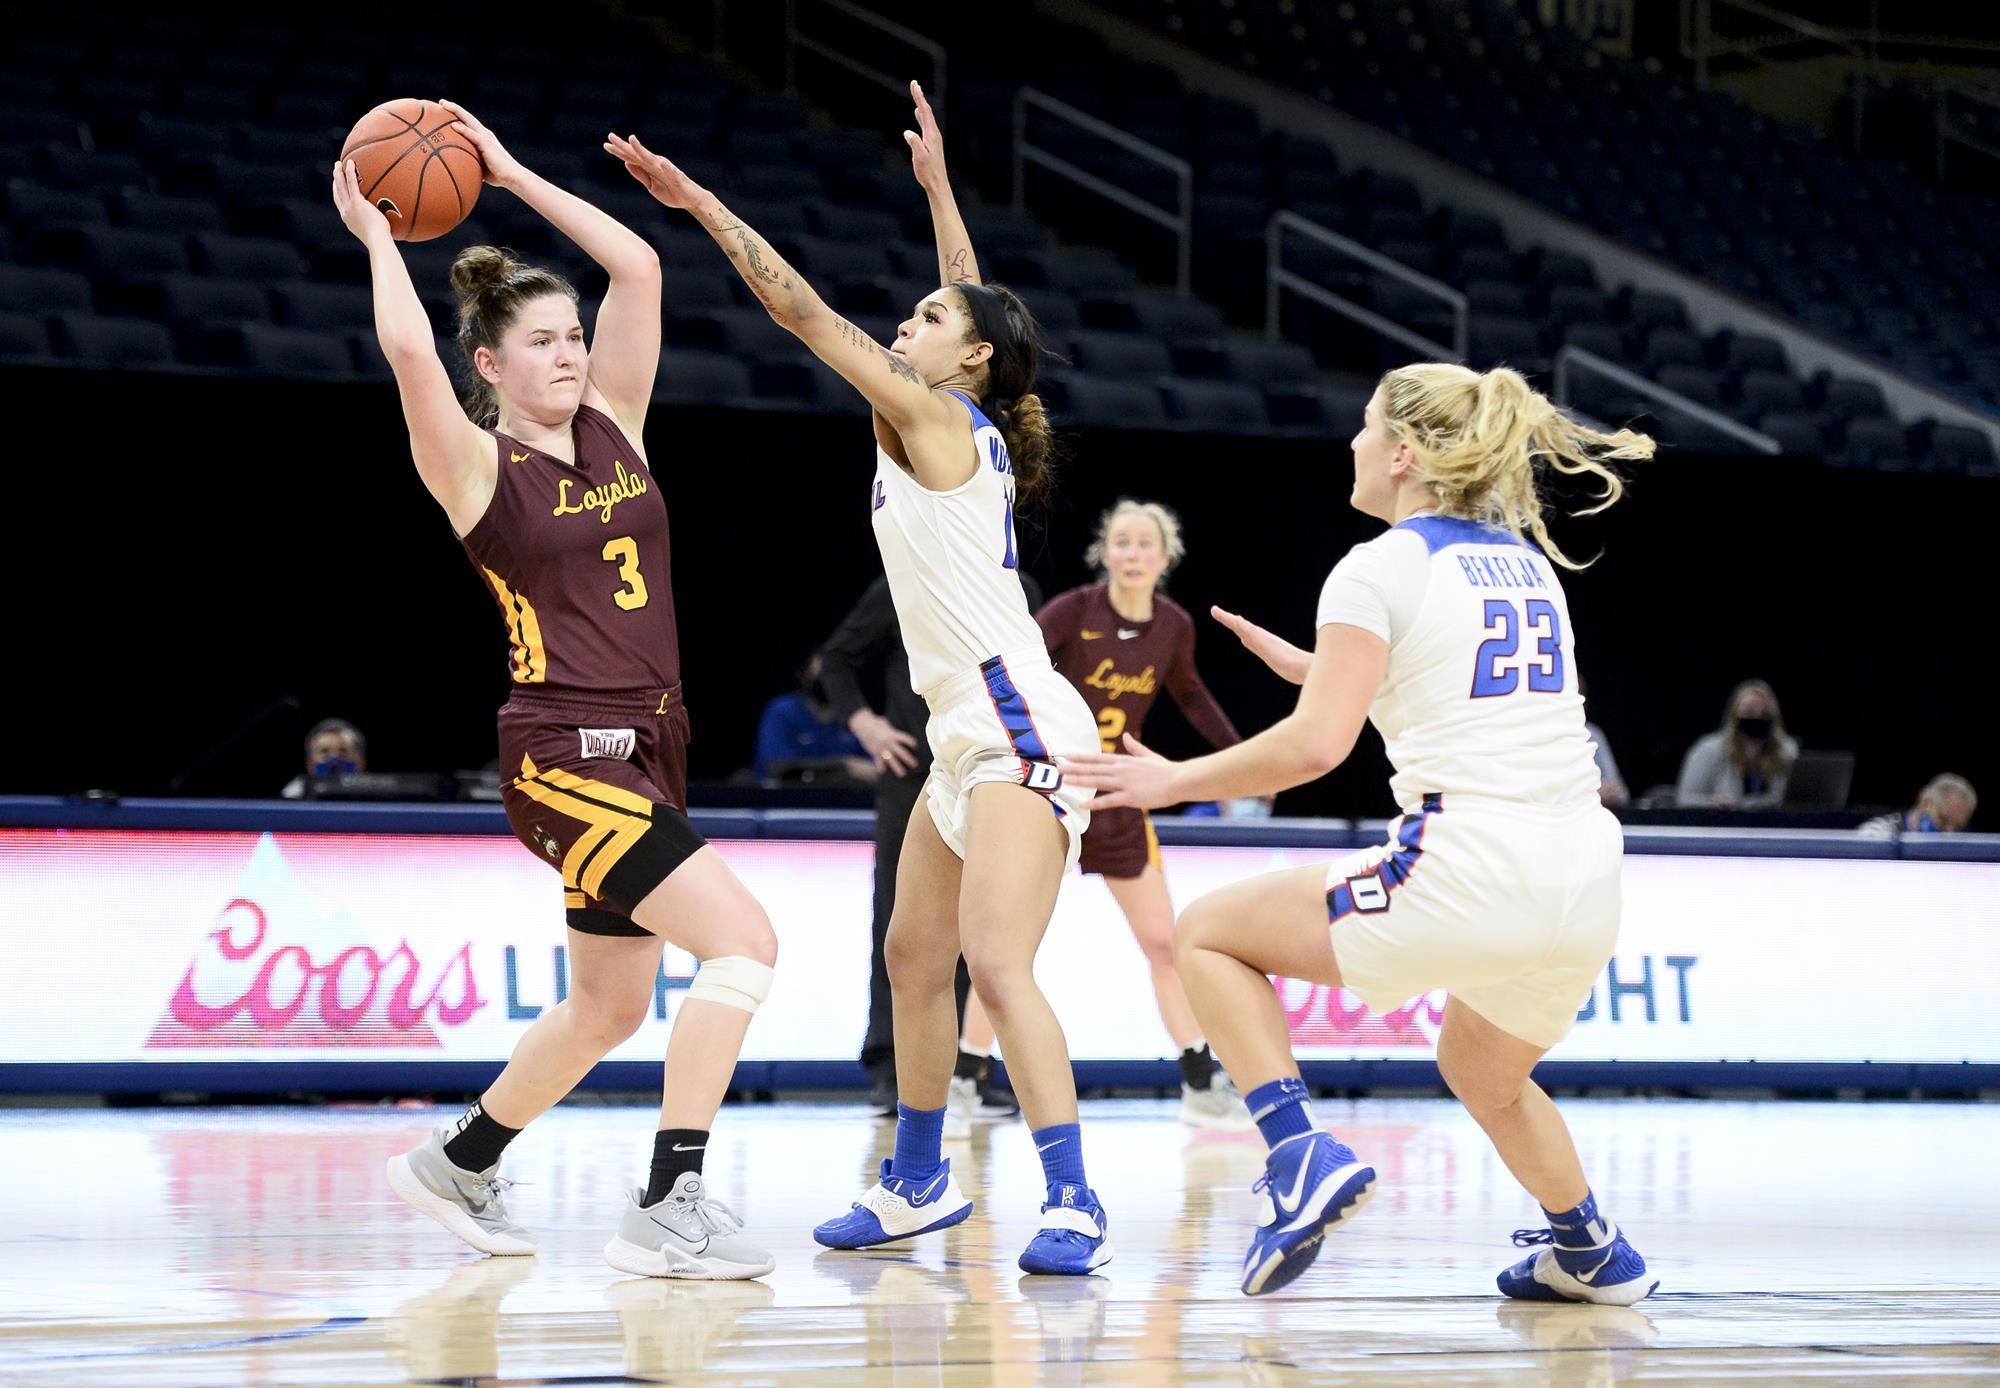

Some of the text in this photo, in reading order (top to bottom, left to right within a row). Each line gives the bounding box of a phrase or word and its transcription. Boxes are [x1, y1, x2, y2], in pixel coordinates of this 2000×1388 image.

[552, 460, 648, 523] Loyola
[602, 536, 649, 611] 3
[1456, 554, 1548, 589] BEKELJA
[1084, 658, 1156, 700] Loyola
[1469, 598, 1565, 699] 23
[170, 898, 487, 1032] Coors
